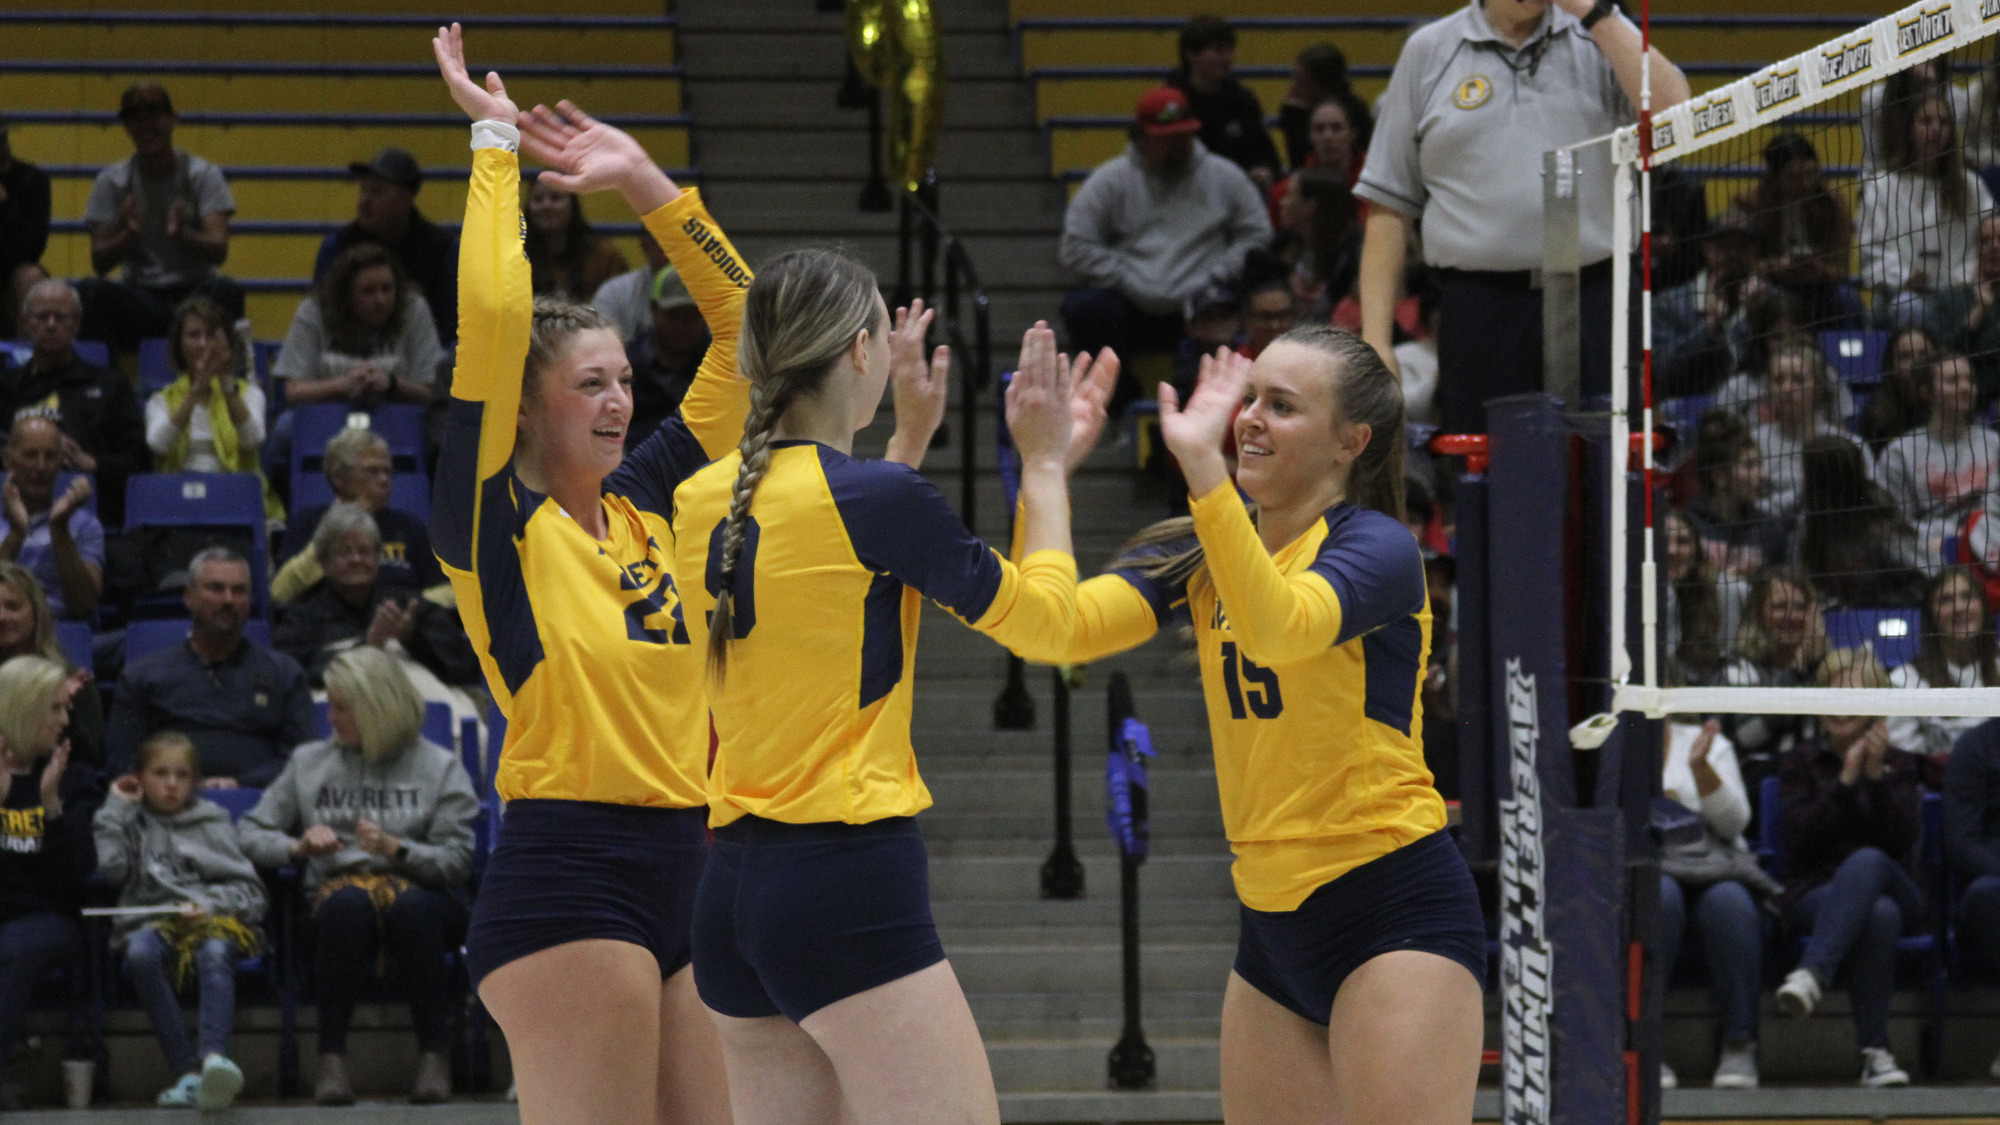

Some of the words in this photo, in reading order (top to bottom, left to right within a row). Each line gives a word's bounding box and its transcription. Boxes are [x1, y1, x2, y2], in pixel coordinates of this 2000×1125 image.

[682, 216, 755, 289] COUGARS
[705, 515, 761, 640] 9
[1221, 641, 1284, 719] 15
[315, 786, 419, 810] AVERETT
[1506, 658, 1545, 945] AVERETT
[1500, 800, 1525, 1125] VOLLEYBAL
[1520, 940, 1553, 1125] UNIVE
